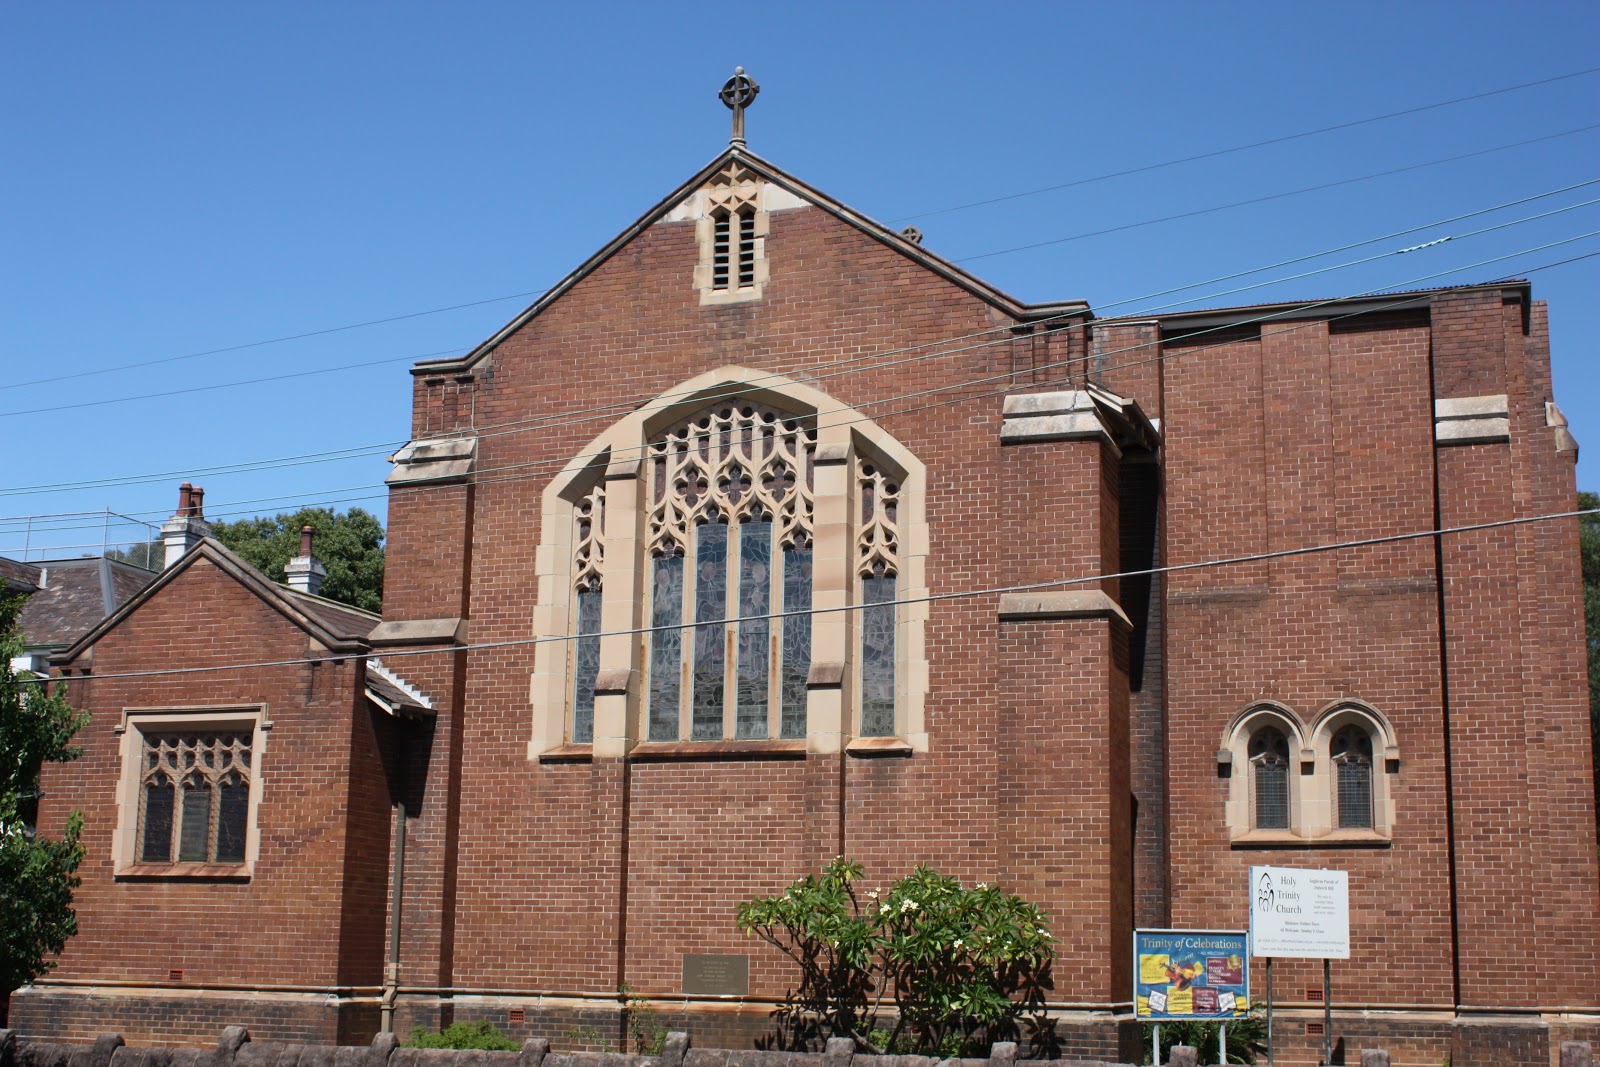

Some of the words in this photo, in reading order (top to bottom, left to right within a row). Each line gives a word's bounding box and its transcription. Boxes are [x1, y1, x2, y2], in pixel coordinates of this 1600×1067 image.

[1281, 876, 1296, 887] Holy
[1277, 890, 1300, 902] Trinity
[1276, 904, 1302, 914] Church
[1142, 938, 1173, 950] Trinity
[1175, 938, 1185, 951] of
[1186, 938, 1242, 949] Celebrations
